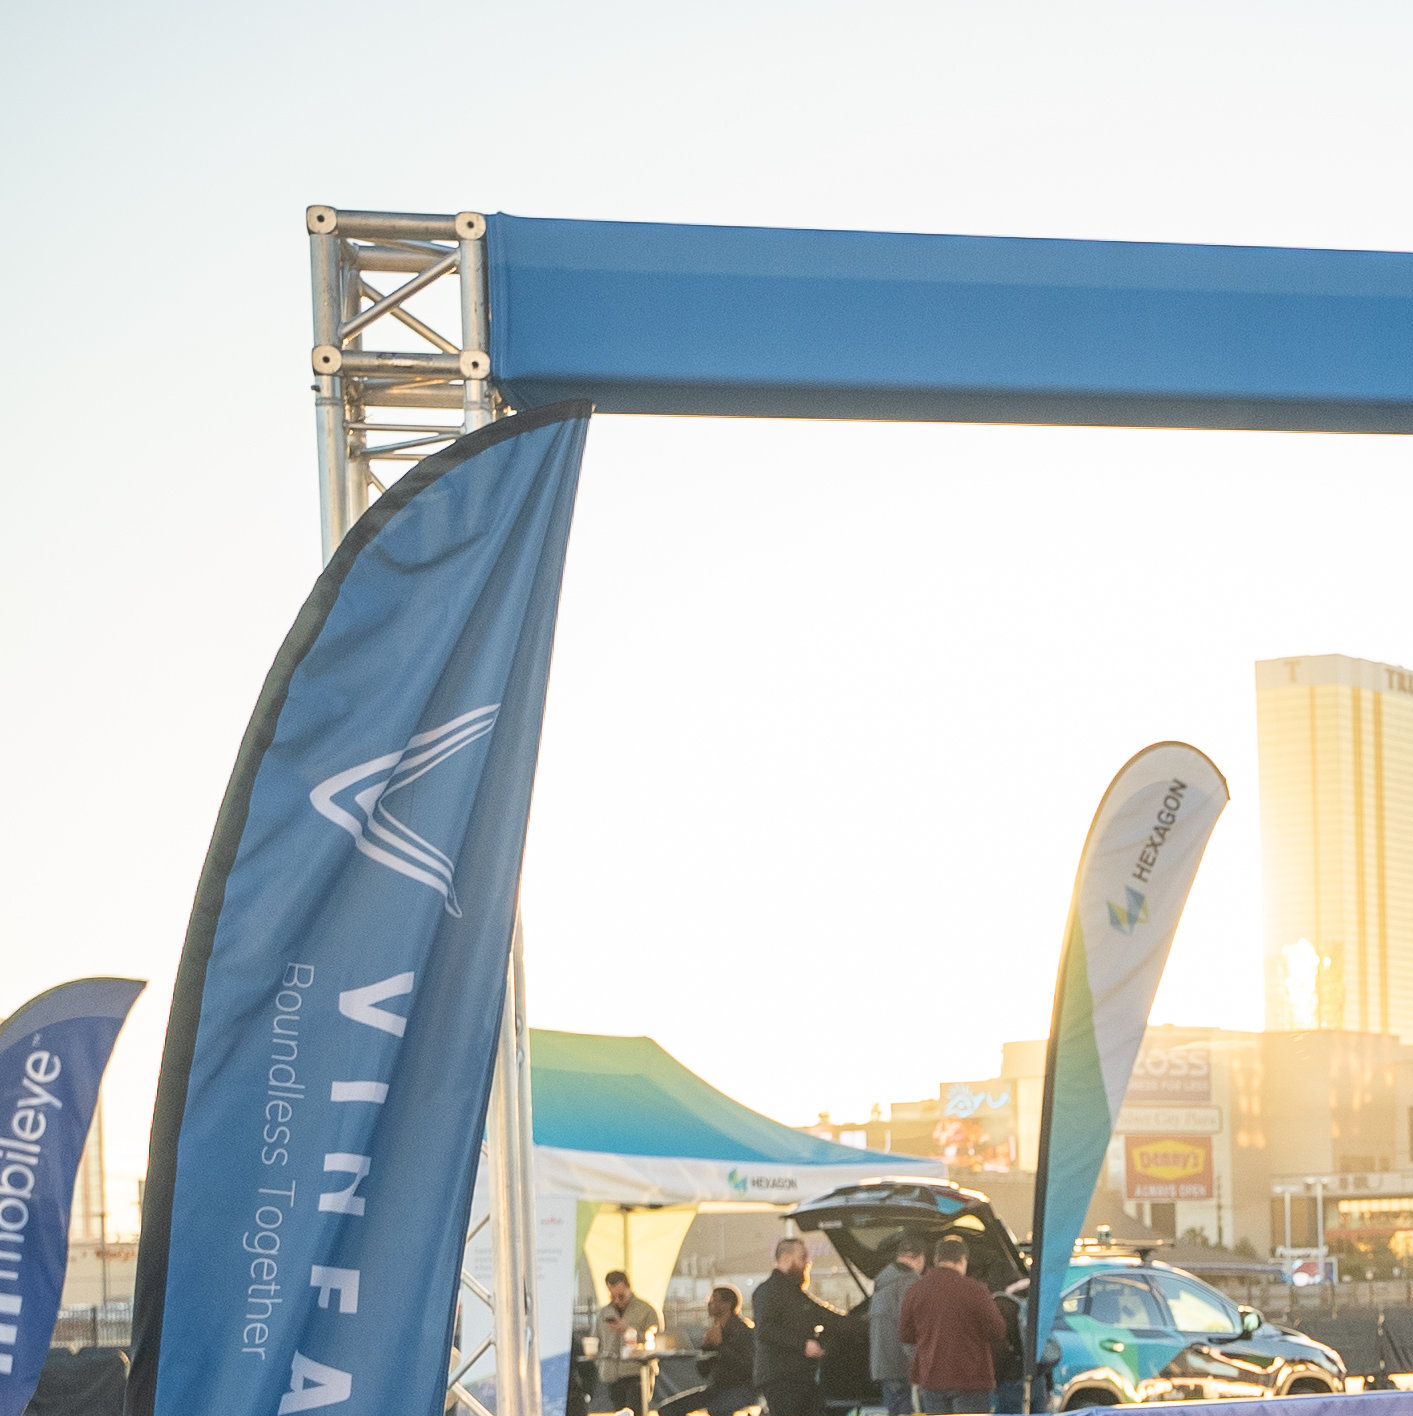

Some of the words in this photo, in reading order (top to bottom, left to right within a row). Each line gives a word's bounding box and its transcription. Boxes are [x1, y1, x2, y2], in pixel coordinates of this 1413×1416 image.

[1132, 777, 1188, 883] HEXAGON
[260, 962, 315, 1167] Boundless
[751, 1176, 798, 1191] HEXAGON
[242, 1178, 298, 1361] Together
